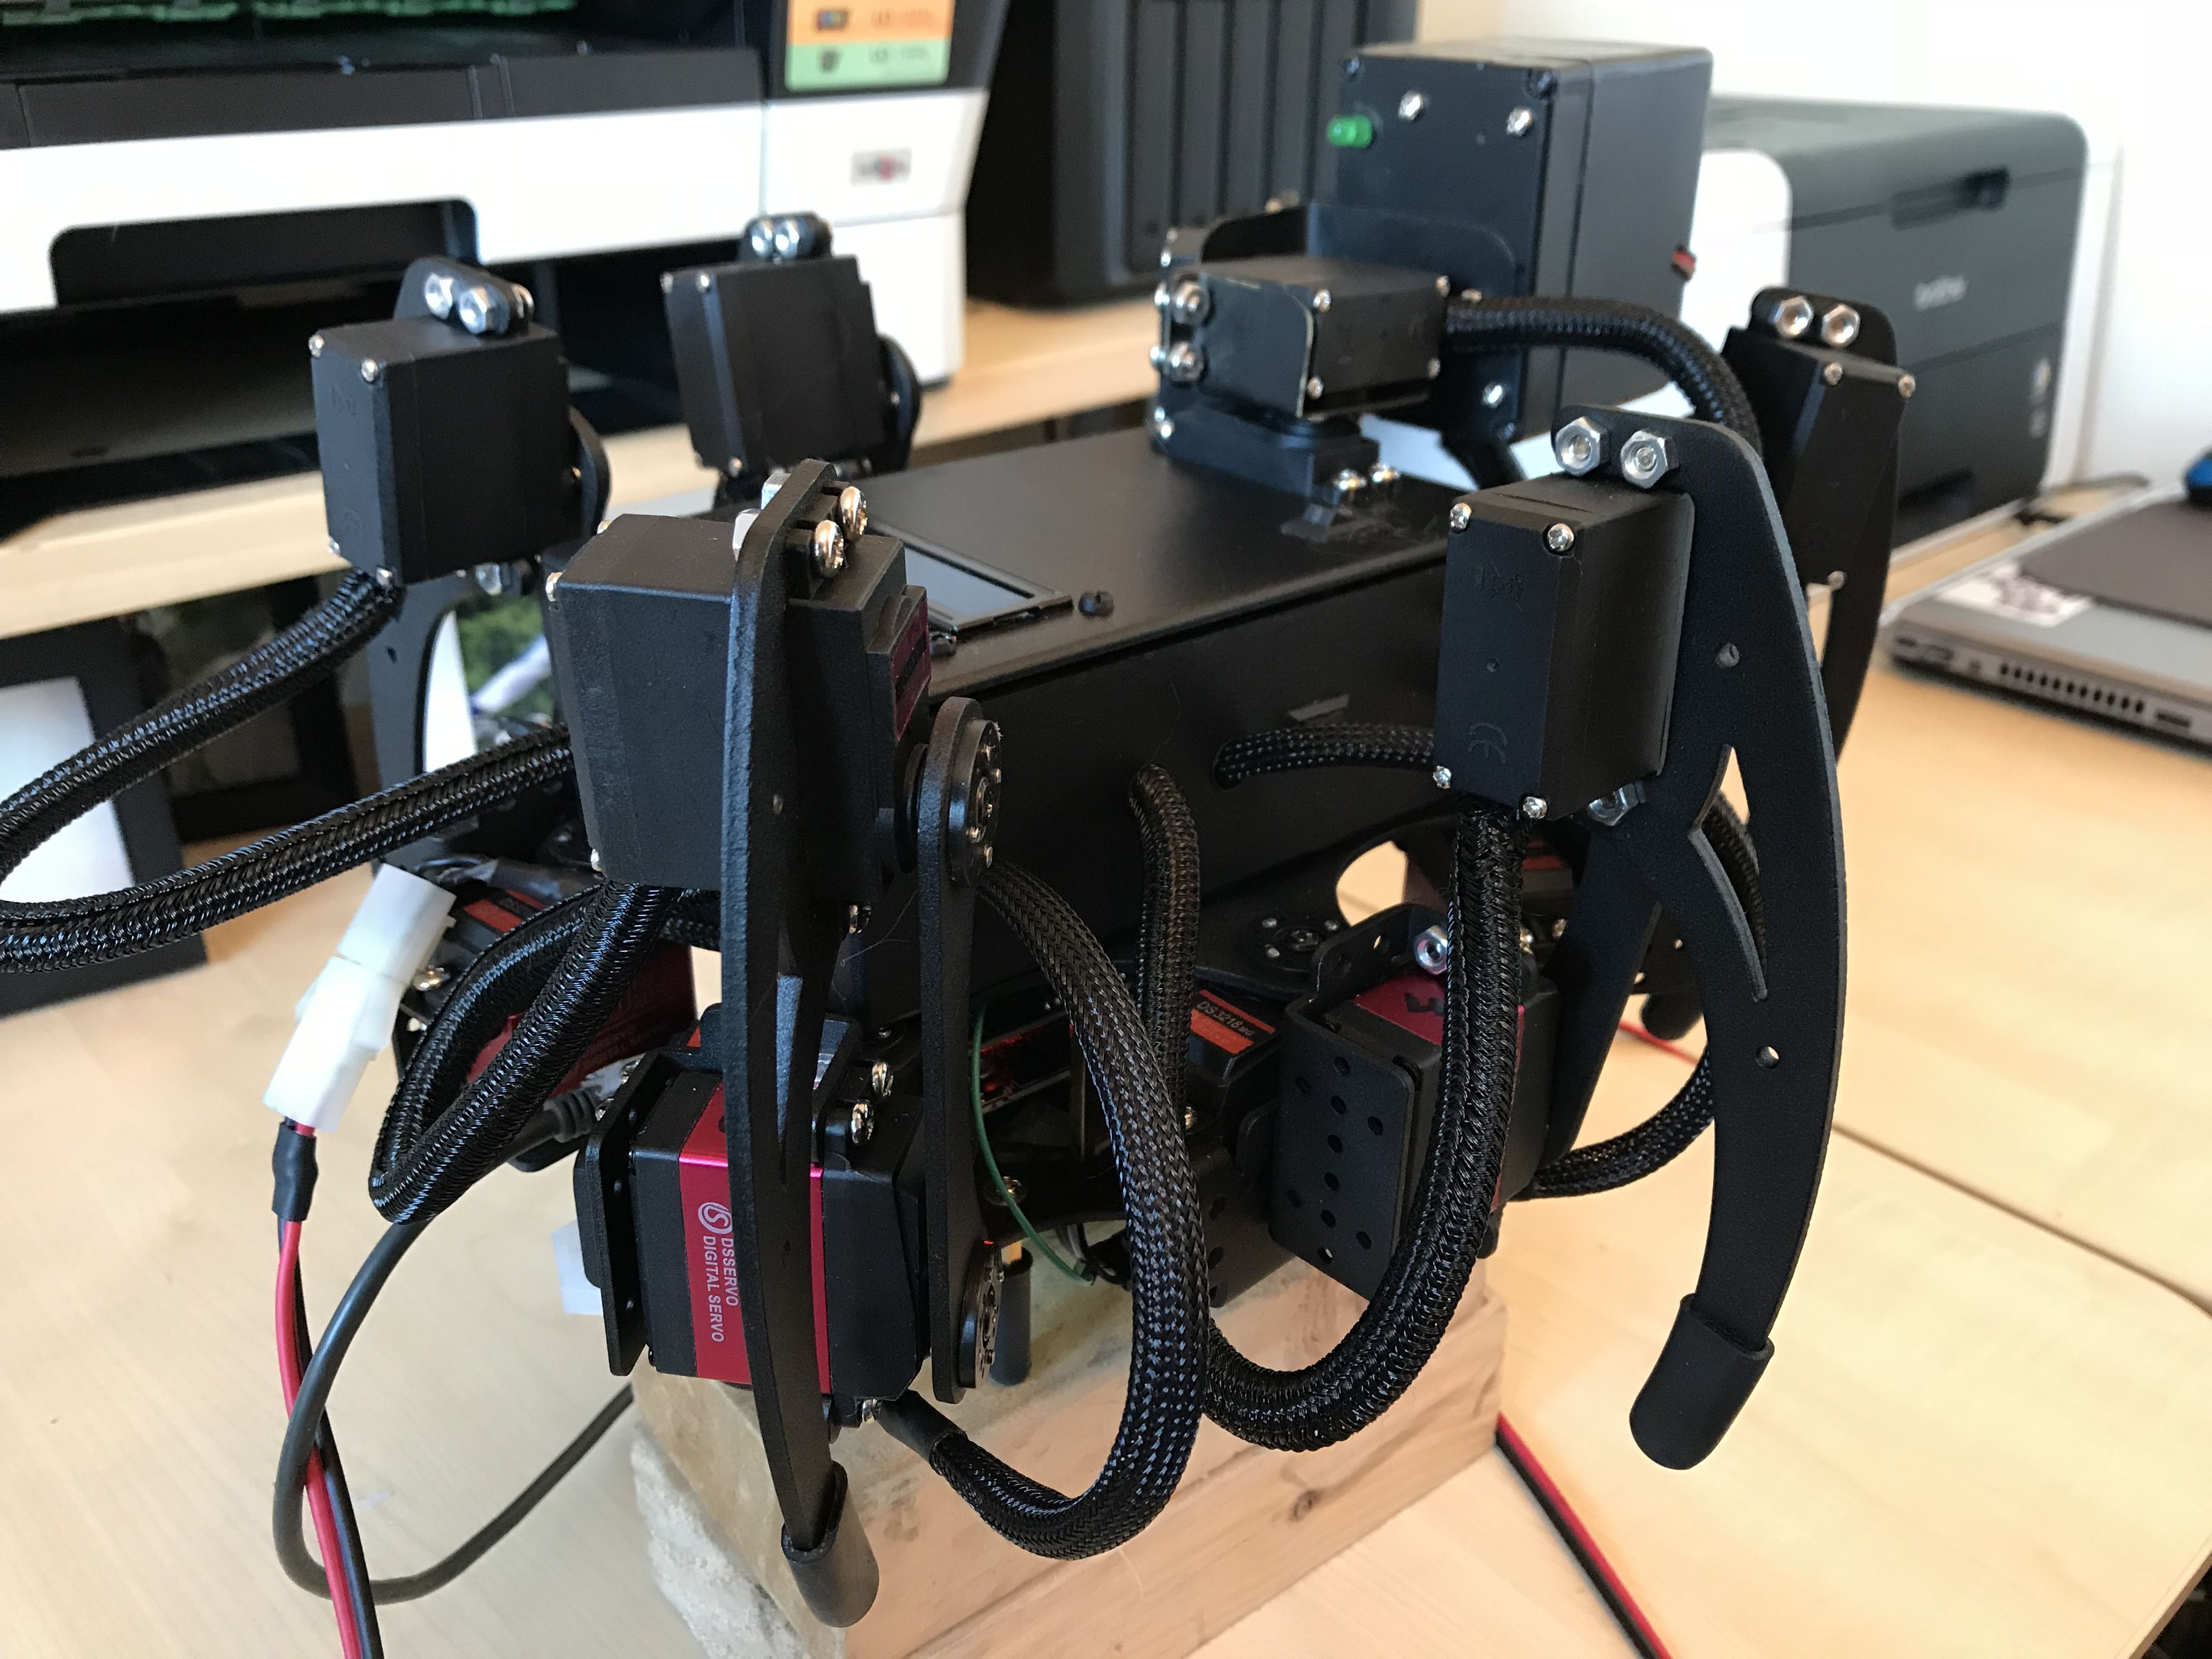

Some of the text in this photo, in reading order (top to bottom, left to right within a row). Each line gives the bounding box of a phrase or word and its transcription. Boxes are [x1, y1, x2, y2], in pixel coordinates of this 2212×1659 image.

[703, 1235, 725, 1342] DIGITAL SERVO
[720, 1237, 739, 1306] DSSERVO
